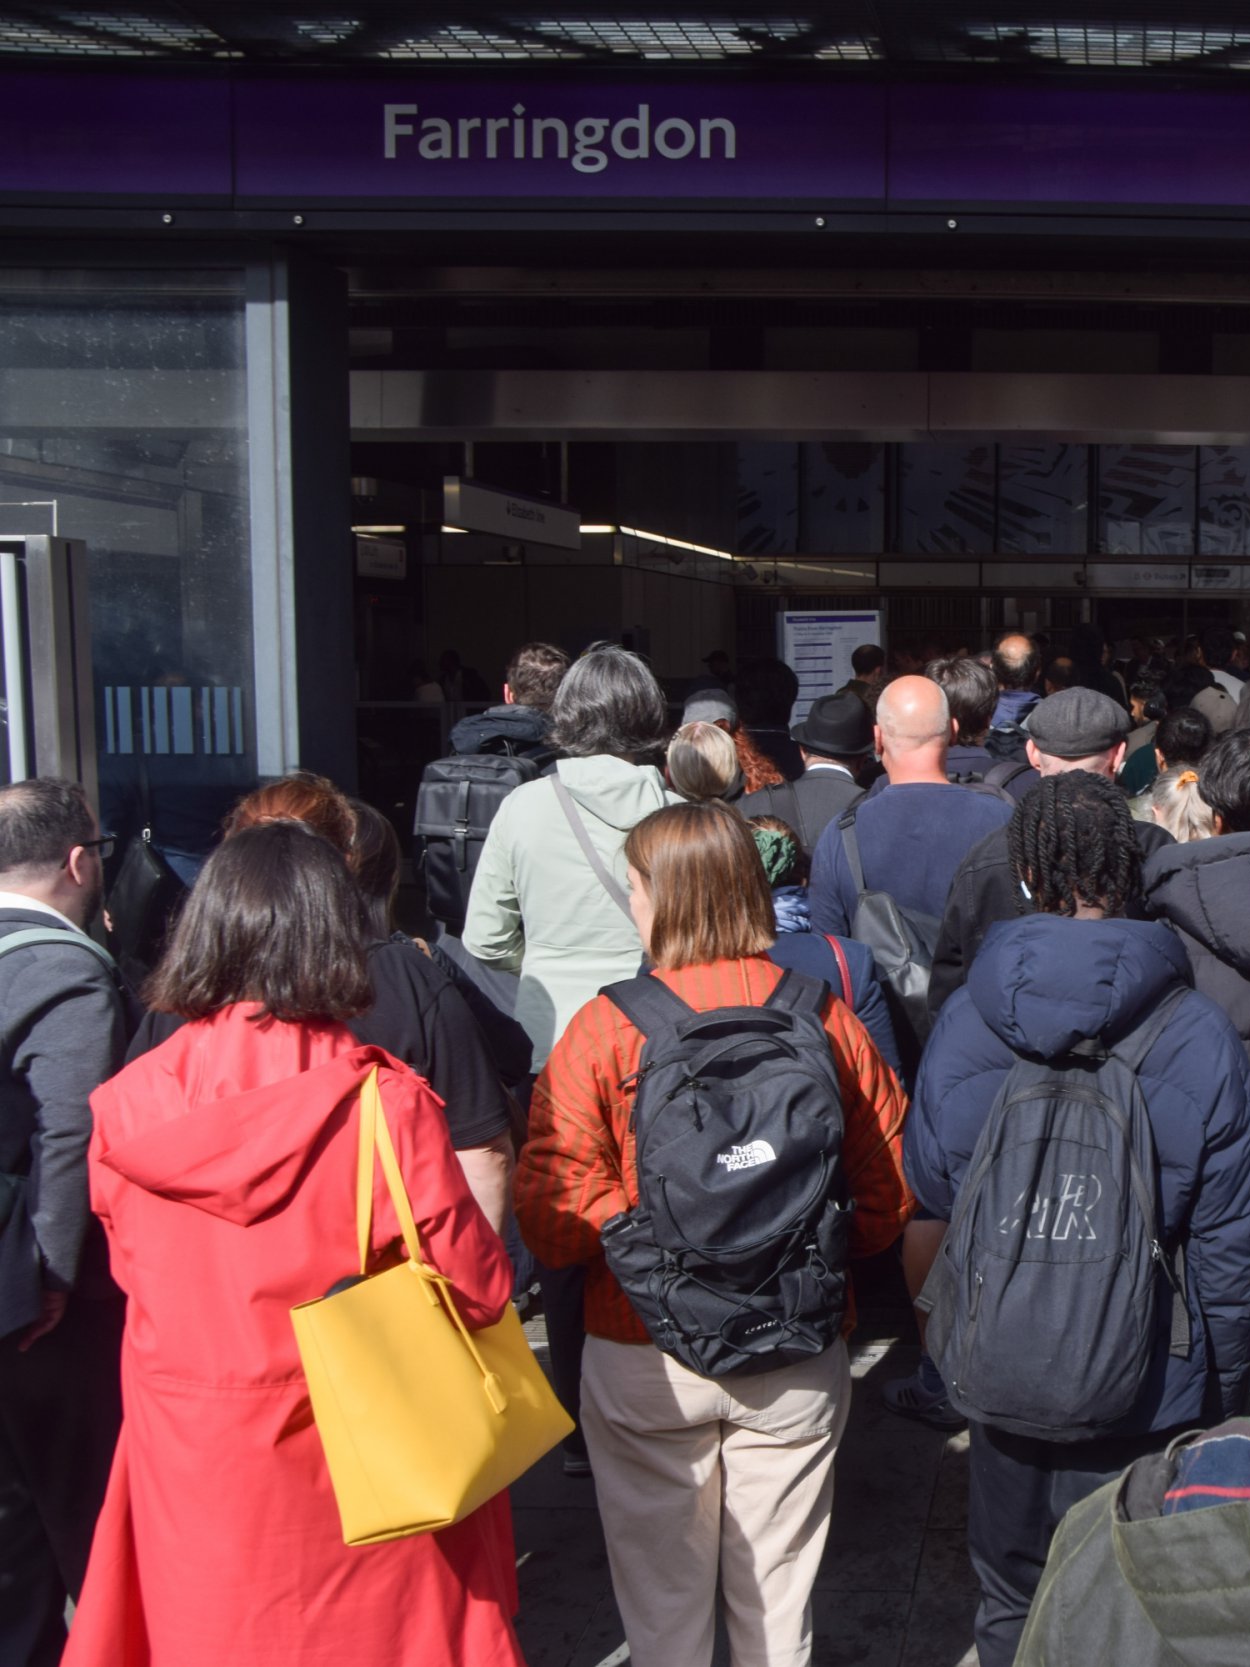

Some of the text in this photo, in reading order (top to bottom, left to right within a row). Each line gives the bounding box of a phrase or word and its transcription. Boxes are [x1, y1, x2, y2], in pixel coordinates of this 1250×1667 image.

[384, 102, 736, 174] Farringdon
[731, 1144, 753, 1155] THE
[716, 1151, 755, 1164] NORTH
[726, 1158, 756, 1172] FACE
